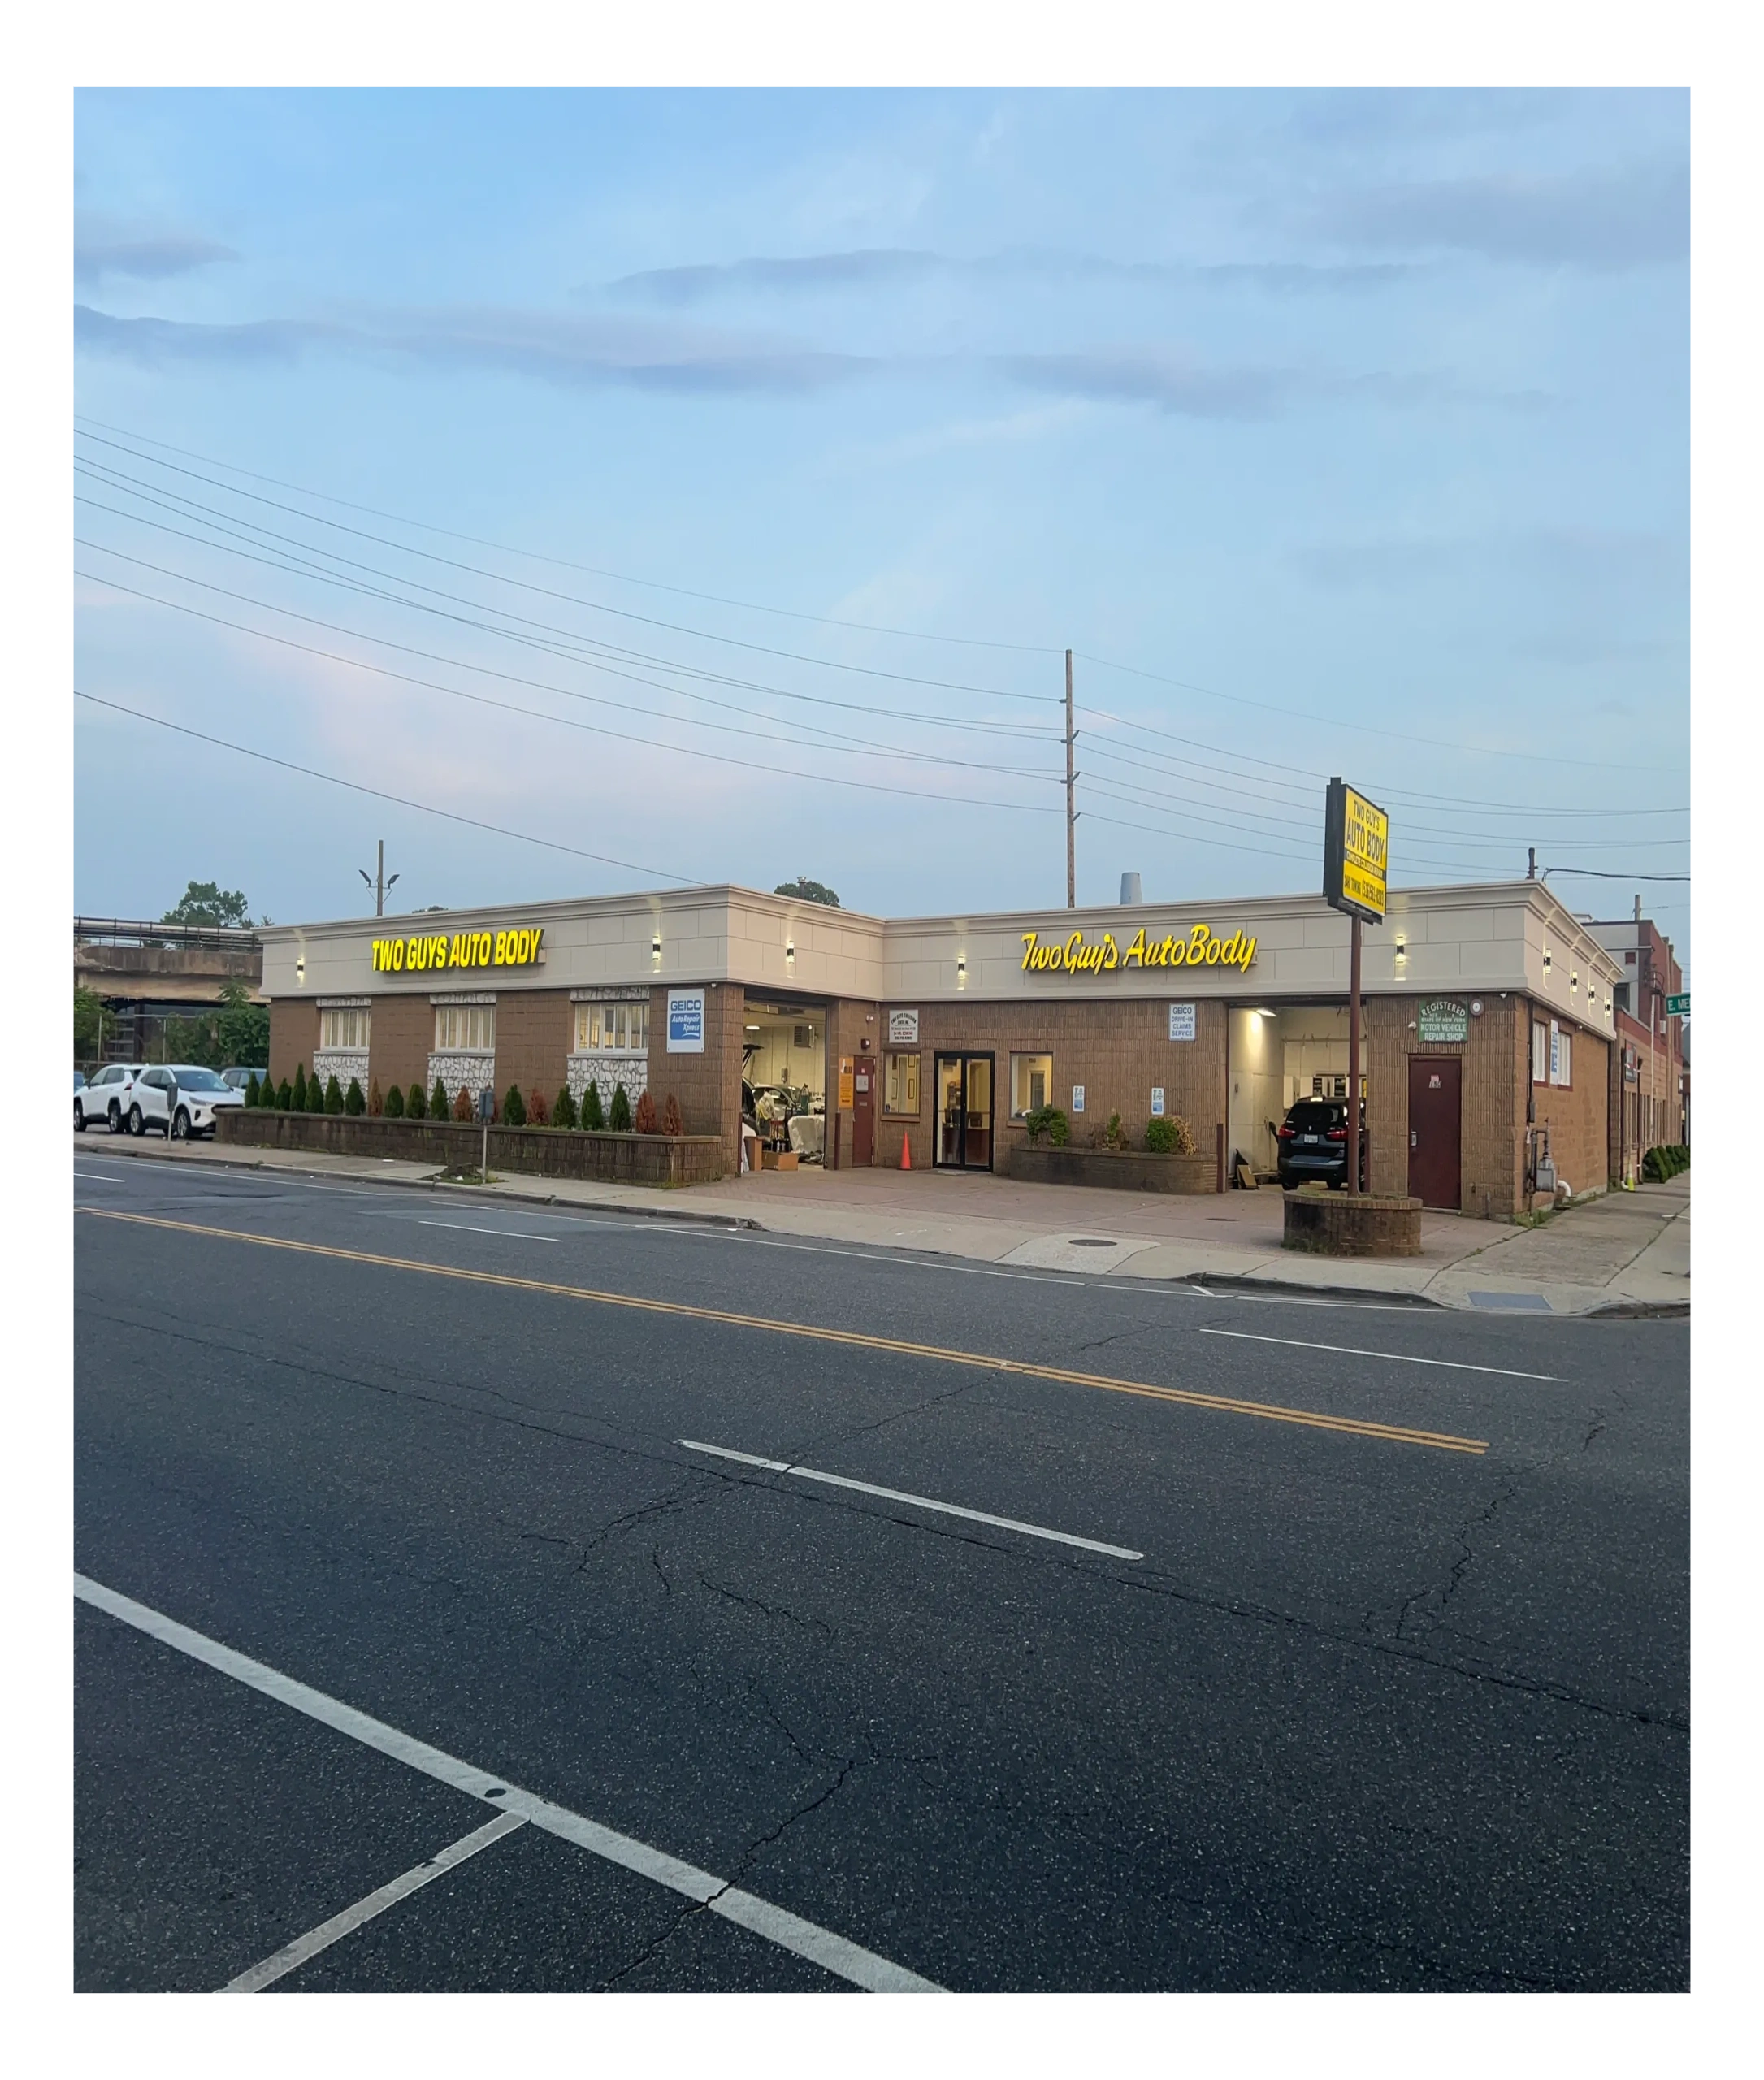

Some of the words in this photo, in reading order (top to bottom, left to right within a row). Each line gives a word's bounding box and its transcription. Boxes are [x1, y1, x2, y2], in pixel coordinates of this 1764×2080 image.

[1354, 799, 1364, 821] TWO
[1366, 808, 1380, 831] GUY'S
[1346, 817, 1365, 853] AUTO
[1367, 828, 1385, 864] BODY
[1346, 851, 1361, 866] COMPLETE
[1361, 859, 1374, 873] COLLISION
[1373, 865, 1383, 878] REPAIR
[372, 938, 405, 972] TWO
[406, 936, 448, 971] GUYS
[448, 932, 492, 968] AUTO
[494, 929, 543, 965] BODY
[1021, 933, 1063, 971] Two
[1063, 931, 1120, 975] Guy's
[670, 999, 702, 1012] GEICO
[1172, 1007, 1192, 1015] GEICO
[1421, 1001, 1466, 1017] REGISTERED
[1668, 1000, 1675, 1011] E.
[683, 1023, 700, 1034] Xpress
[1420, 1024, 1441, 1032] MOTOR
[1441, 1024, 1467, 1032] VEHICLE
[1424, 1032, 1445, 1041] REPAIR
[1446, 1033, 1463, 1042] SHOP
